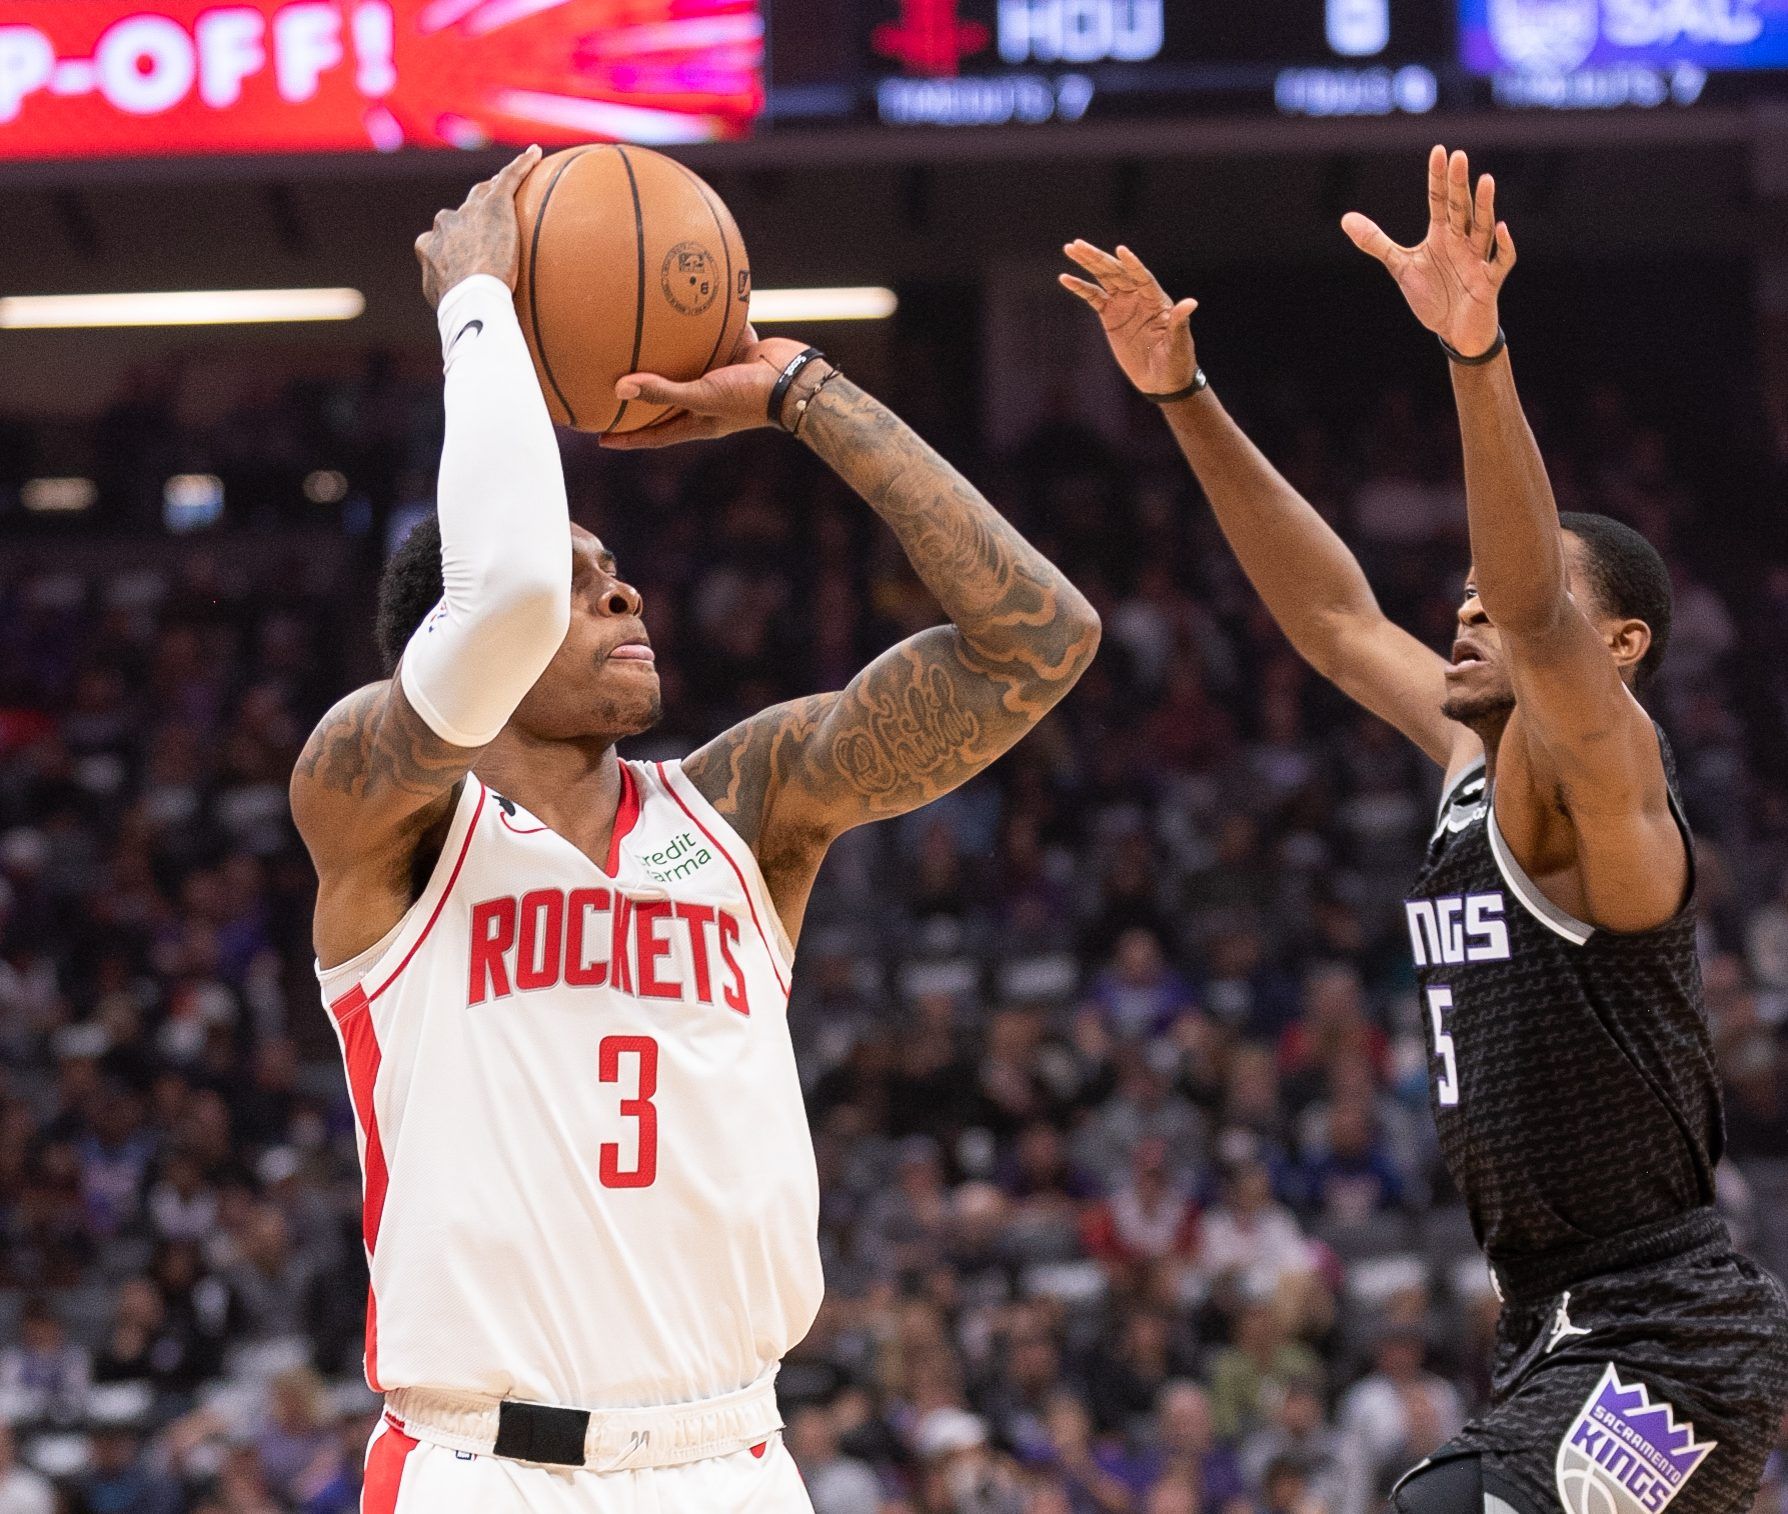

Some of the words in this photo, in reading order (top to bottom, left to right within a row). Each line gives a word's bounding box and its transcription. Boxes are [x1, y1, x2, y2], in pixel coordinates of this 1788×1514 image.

[997, 0, 1163, 62] HOU
[646, 849, 712, 882] arma
[466, 886, 751, 1019] ROCKETS
[1427, 985, 1460, 1106] 5
[599, 1036, 658, 1188] 3
[1571, 1420, 1672, 1513] KINGS
[1593, 1405, 1682, 1484] SACRAMENTO
